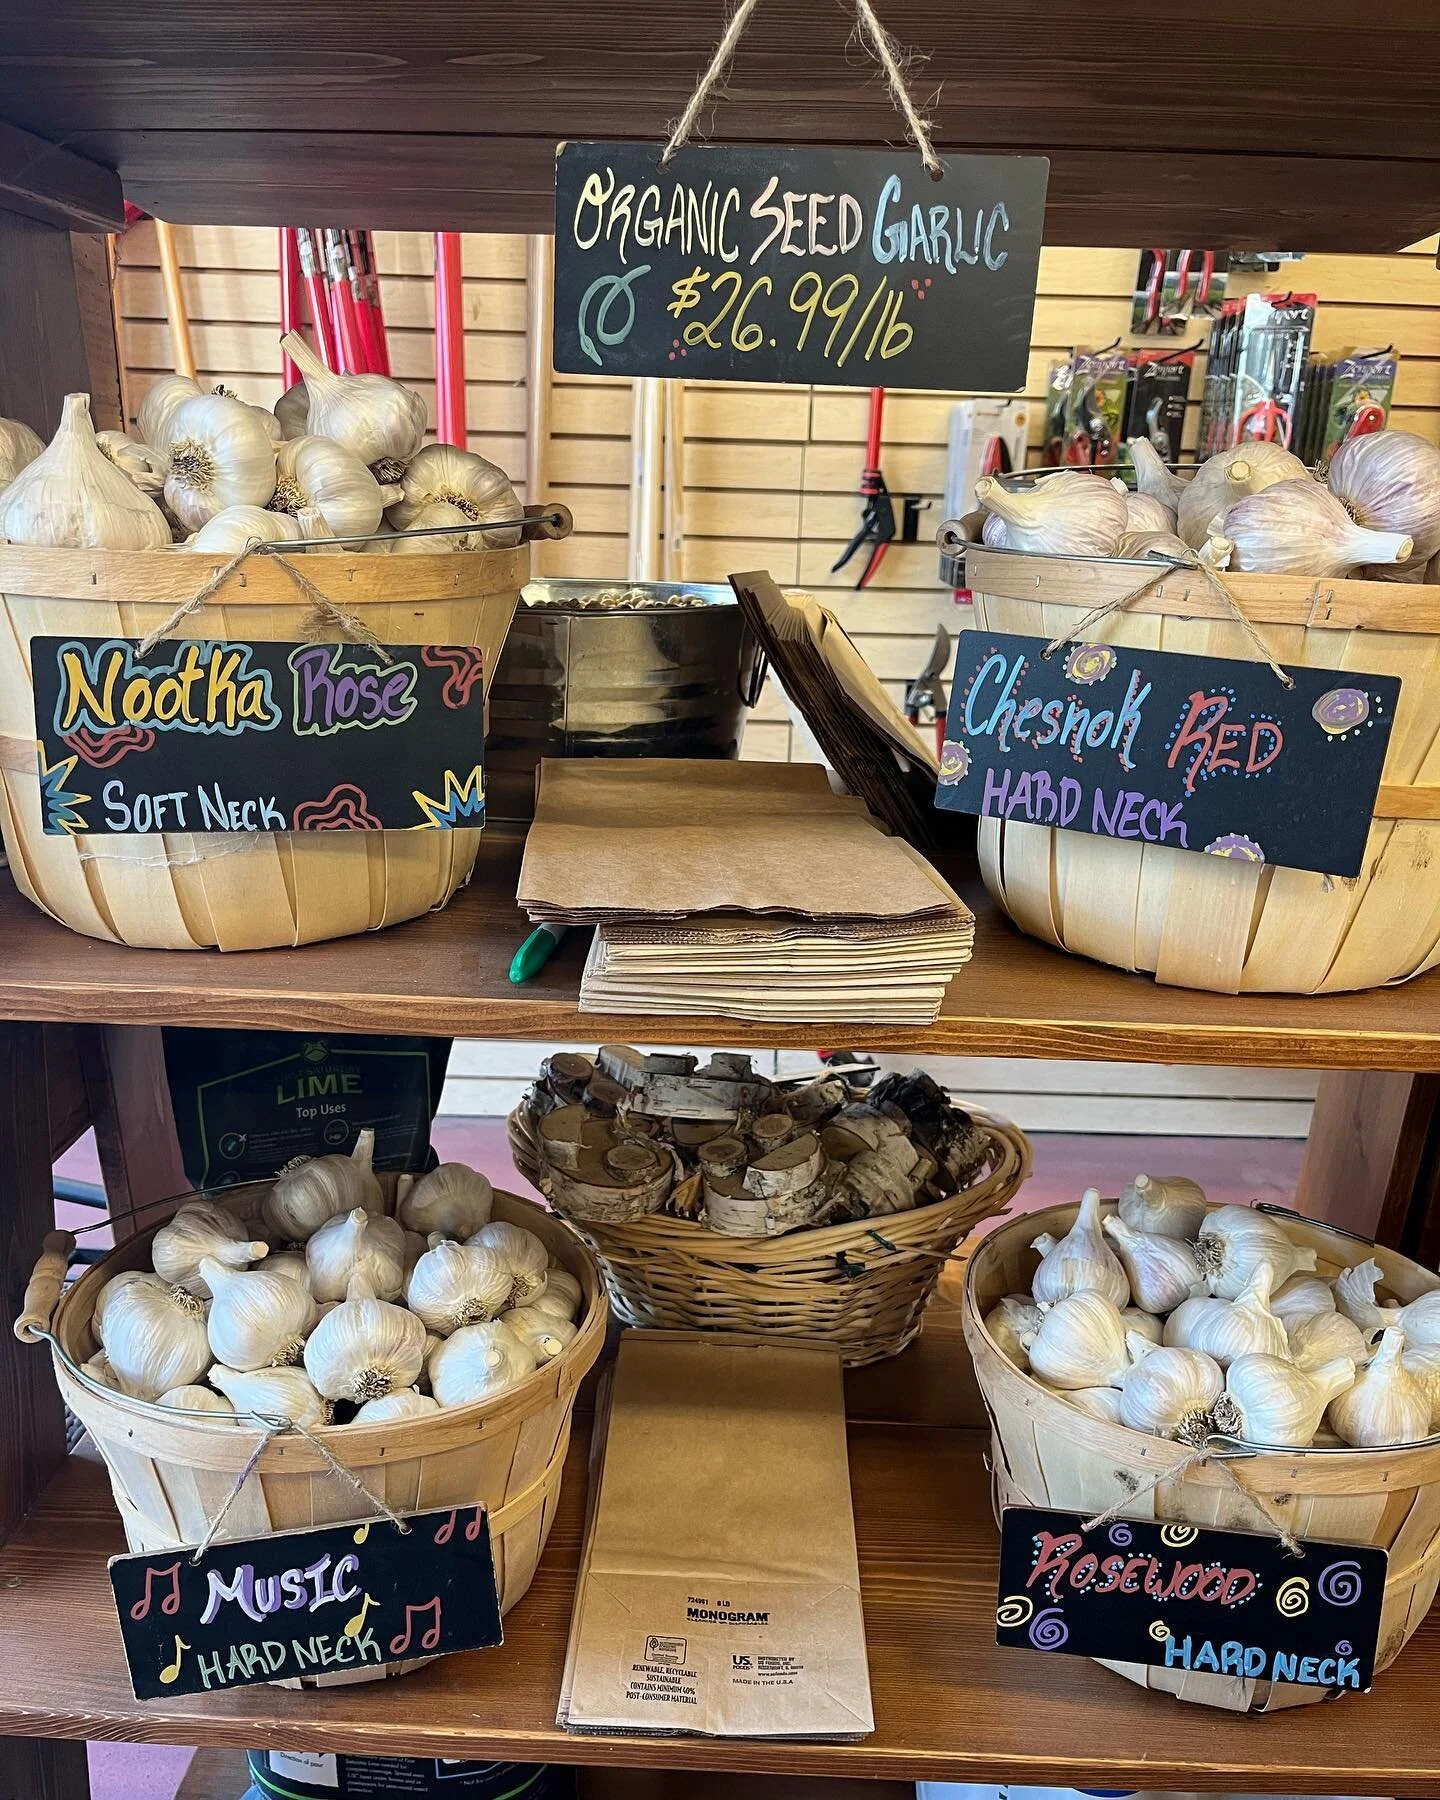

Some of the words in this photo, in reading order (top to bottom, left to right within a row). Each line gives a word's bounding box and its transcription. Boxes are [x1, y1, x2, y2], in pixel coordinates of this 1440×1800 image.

[574, 167, 740, 265] ORGANIC
[749, 176, 863, 265] SEED
[871, 174, 1010, 275] GARLIC
[667, 265, 914, 367] $26.99/lb
[290, 647, 412, 726] Rose
[963, 652, 1153, 769] Chesnok
[1167, 690, 1285, 794] RED
[102, 779, 188, 832] SOFT
[197, 782, 287, 832] NECK
[981, 767, 1082, 828] HARD
[1092, 787, 1189, 849] NECK
[277, 1073, 364, 1105] LIME
[296, 1106, 318, 1119] Top
[320, 1103, 347, 1116] Uses
[200, 1553, 363, 1625] MUSIC
[1025, 1530, 1258, 1606] ROSEWOOD
[687, 1607, 770, 1622] MONOGRAM
[198, 1639, 288, 1689] HARD
[292, 1627, 382, 1668] NECK
[630, 1681, 657, 1692] CONTAINS
[1164, 1634, 1267, 1678] HARD
[1271, 1650, 1361, 1689] NECK
